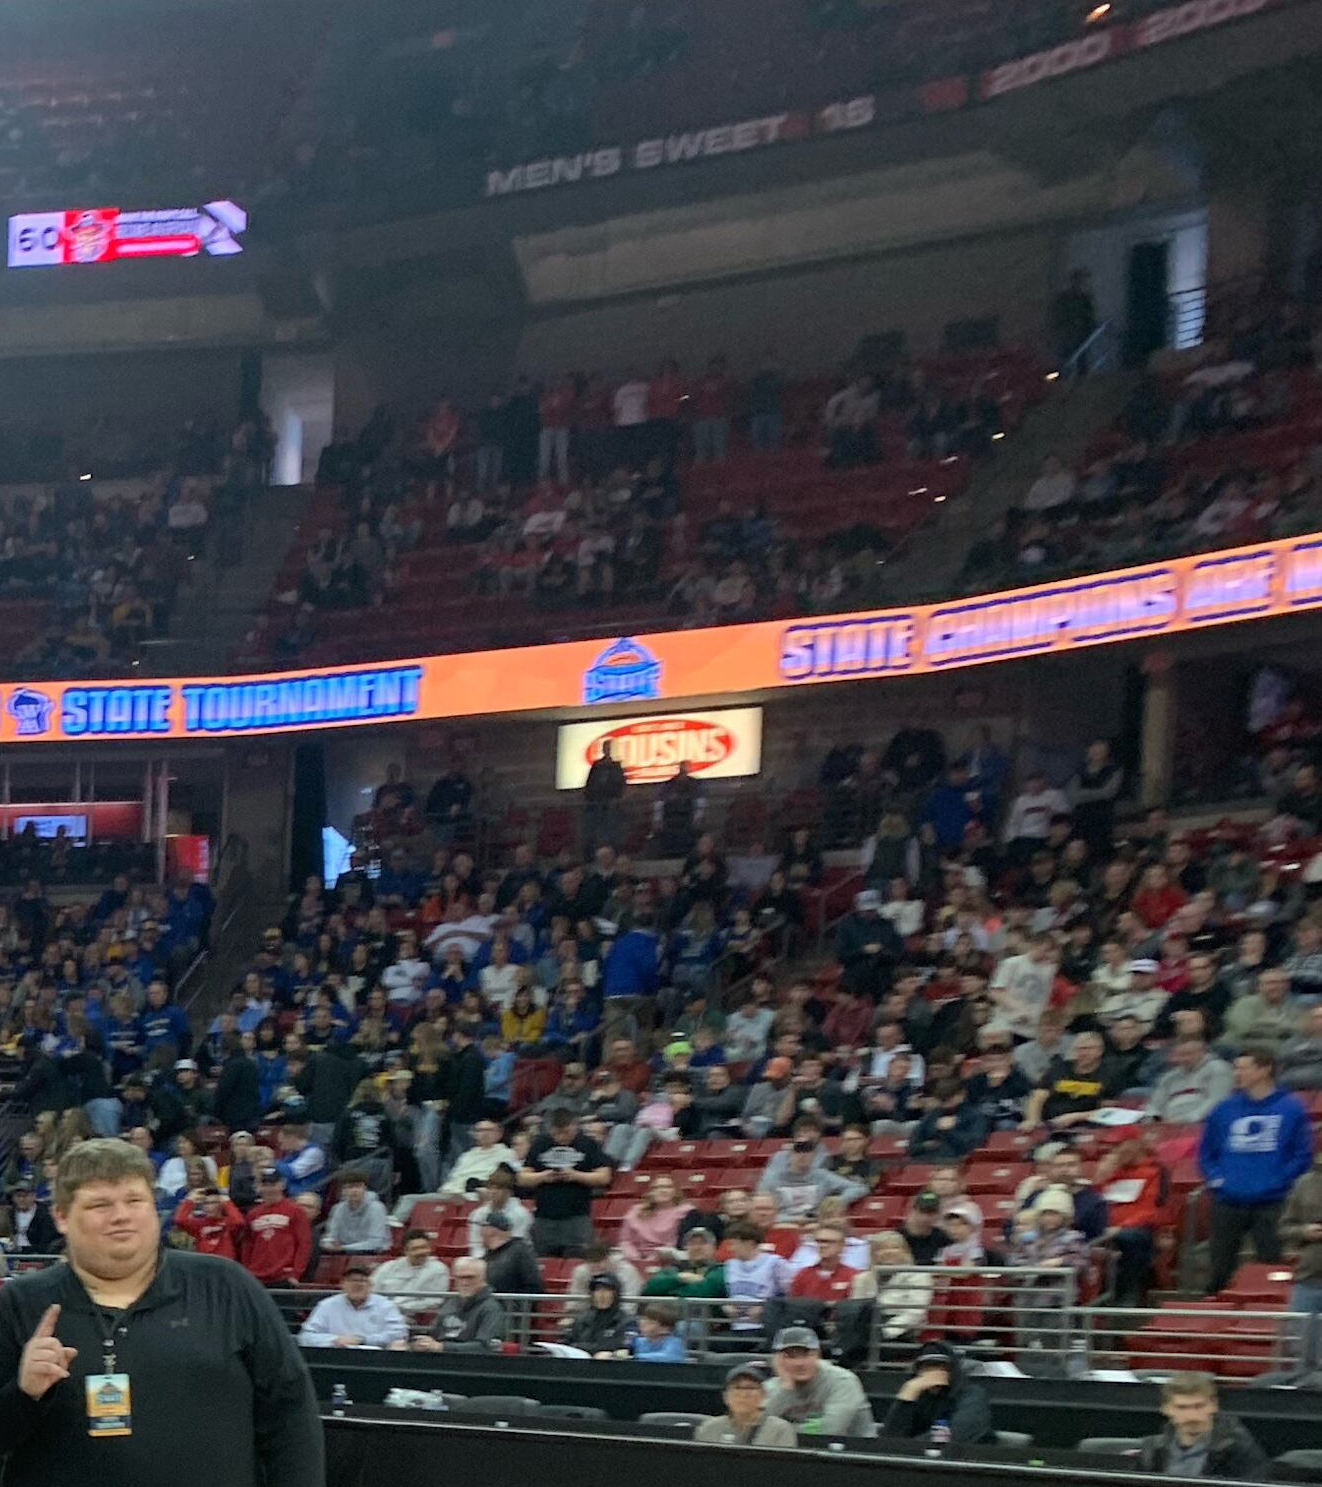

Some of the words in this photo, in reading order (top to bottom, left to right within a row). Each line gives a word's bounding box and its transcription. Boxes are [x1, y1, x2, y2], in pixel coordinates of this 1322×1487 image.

[487, 147, 621, 196] MEN'S
[636, 115, 787, 168] SWEET
[780, 614, 918, 681] STATE
[60, 685, 172, 736] STATE
[181, 664, 424, 733] TOURNAMENT
